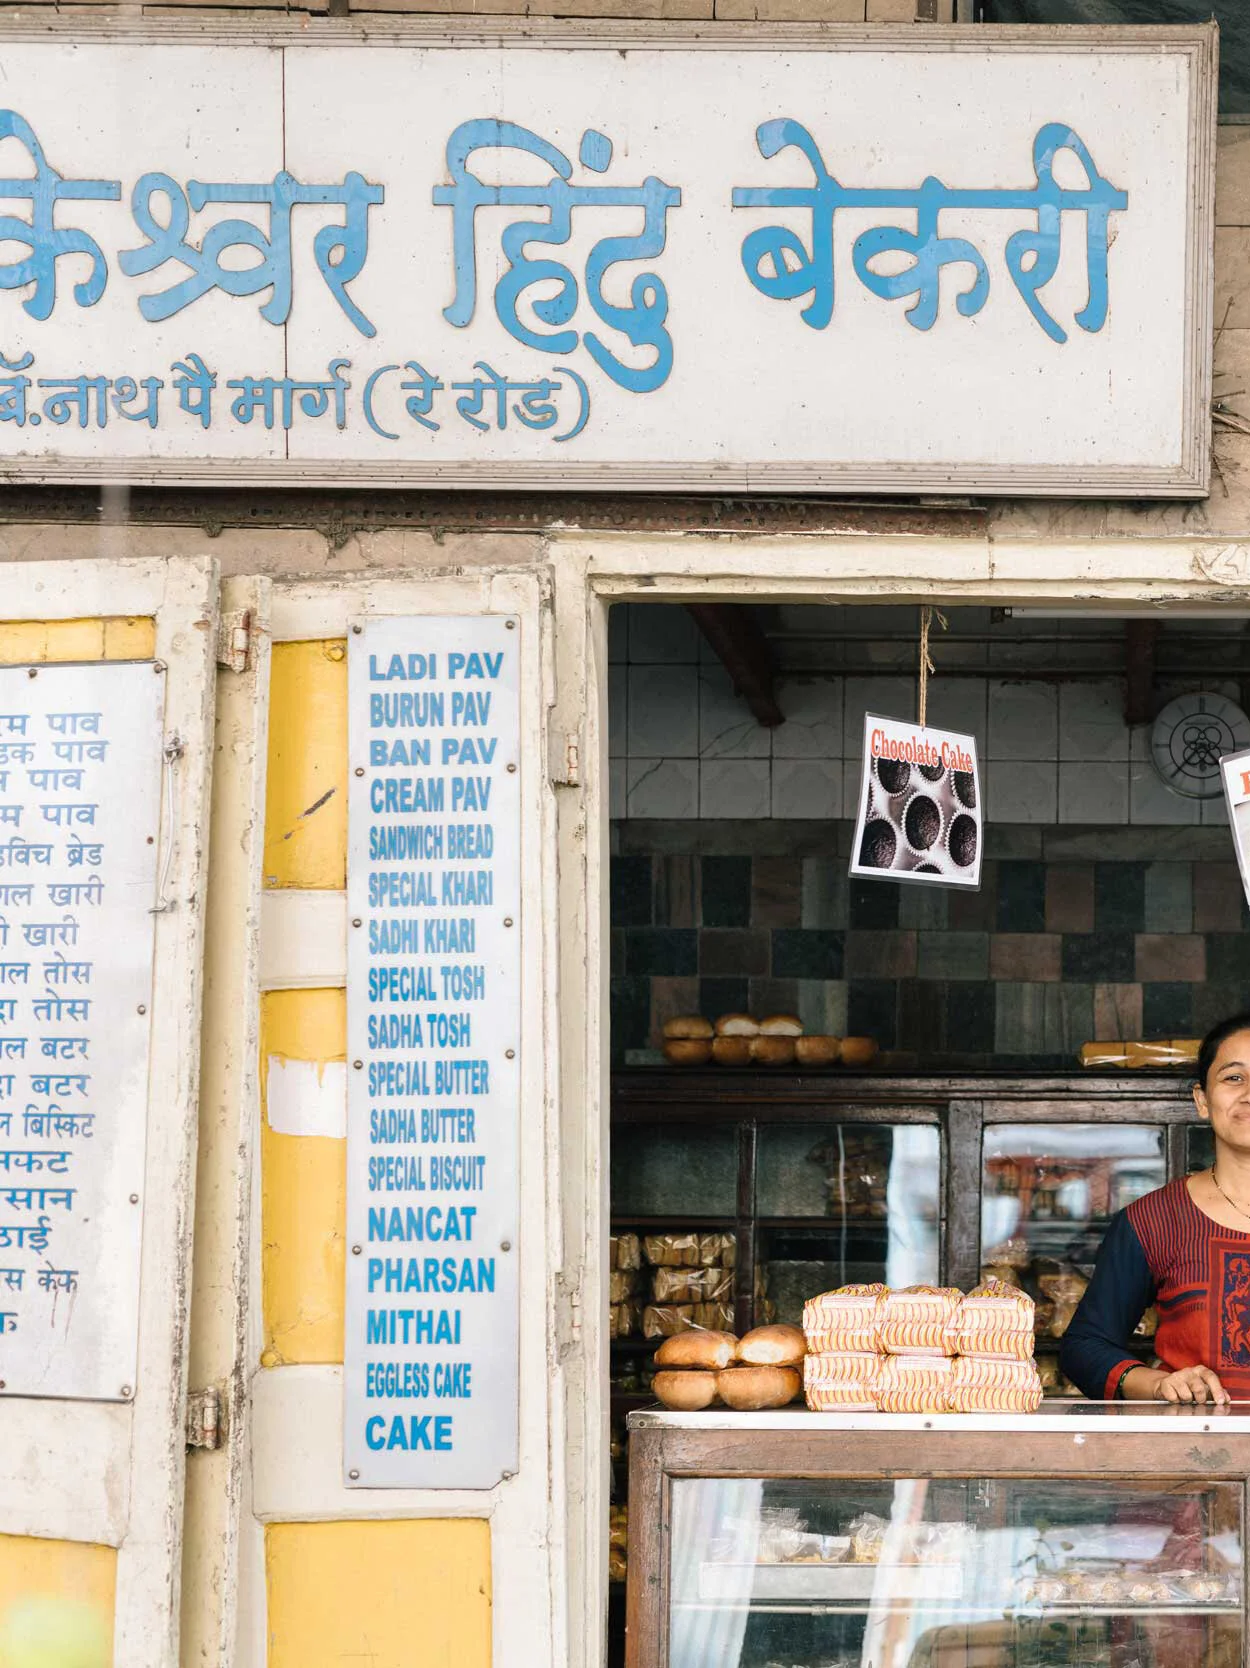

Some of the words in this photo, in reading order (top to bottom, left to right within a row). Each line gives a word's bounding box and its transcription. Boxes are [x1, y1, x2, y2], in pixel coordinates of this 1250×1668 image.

[732, 117, 1129, 343] बेकरी
[172, 352, 217, 430] पै
[227, 358, 351, 430] मार्ग
[452, 361, 591, 442] रोड)
[369, 653, 436, 681] LADI
[448, 652, 504, 679] PAV
[46, 713, 103, 734] पाव
[370, 692, 444, 728] BURUN
[452, 691, 491, 726] PAV
[52, 741, 110, 762] पाव
[370, 739, 431, 766] BAN
[442, 738, 498, 765] PAV
[871, 728, 939, 767] Chocolate
[942, 741, 973, 772] Cake
[27, 769, 85, 791] पाव
[370, 777, 444, 814] CREAM
[452, 776, 491, 812] PAV
[40, 804, 99, 826] पाव
[66, 833, 104, 867] ब्रेड
[369, 825, 443, 861] SANDWICH
[448, 824, 493, 859] BREAD
[46, 875, 105, 906] खारी
[368, 872, 437, 907] SPECIAL
[442, 871, 493, 906] KHARI
[21, 915, 80, 946] खारी
[369, 920, 418, 955] SADHI
[424, 918, 475, 953] KHARI
[43, 951, 93, 984] तोस
[368, 967, 437, 1003] SPECIAL
[440, 965, 484, 1001] TOSH
[32, 988, 92, 1021] तोस
[368, 1014, 423, 1049] SADHA
[427, 1013, 470, 1048] TOSH
[40, 1038, 90, 1060] बटर
[29, 1074, 91, 1097] बटर
[368, 1061, 430, 1097] SPECIAL
[435, 1060, 489, 1095] BUTTER
[22, 1104, 96, 1138] बिस्किट
[370, 1109, 417, 1144] SADHA
[421, 1108, 475, 1143] BUTTER
[368, 1156, 426, 1191] SPECIAL
[430, 1156, 486, 1191] BISCUIT
[368, 1206, 477, 1242] NANCAT
[37, 1260, 79, 1293] केक
[368, 1257, 495, 1293] PHARSAN
[366, 1309, 461, 1344] MITHAI
[366, 1362, 430, 1398] EGGLESS
[434, 1363, 472, 1398] CAKE
[365, 1415, 453, 1451] CAKE
